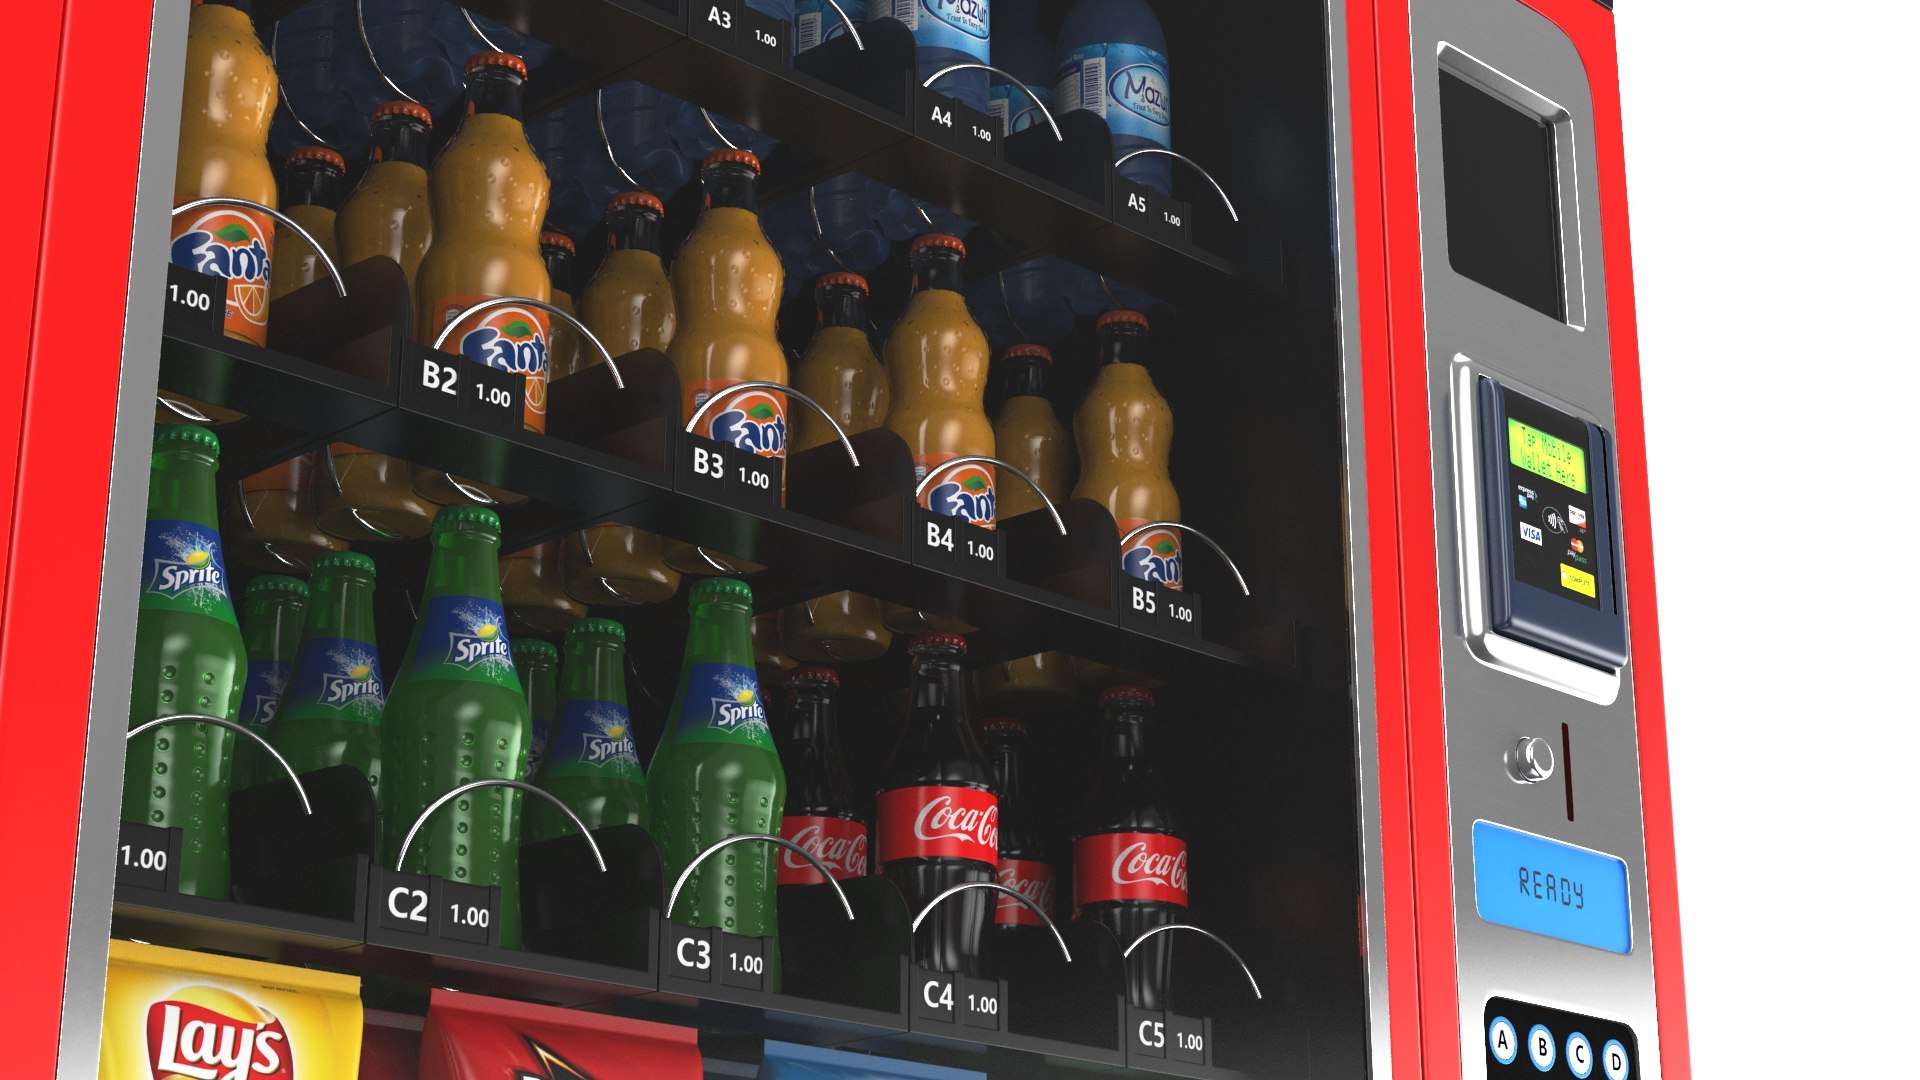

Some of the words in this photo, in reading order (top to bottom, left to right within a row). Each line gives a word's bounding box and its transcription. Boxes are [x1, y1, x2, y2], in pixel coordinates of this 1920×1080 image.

[708, 5, 731, 29] A3
[755, 29, 777, 47] 1.00
[931, 105, 953, 128] A4
[972, 126, 991, 142] 1.00
[1127, 192, 1146, 213] A5
[1163, 211, 1181, 227] 1.00
[169, 284, 210, 311] 1.00
[422, 359, 458, 396] B2
[476, 383, 511, 408] 1.00
[693, 446, 724, 479] B3
[738, 466, 769, 489] 1.00
[927, 481, 996, 523] Fant
[927, 521, 954, 552] B4
[967, 540, 994, 561] 1.00
[1523, 526, 1541, 542] VISA
[158, 562, 220, 592] Sprite
[1132, 586, 1156, 614] B5
[1168, 603, 1193, 622] 1.00
[454, 637, 508, 662] Sprite
[327, 678, 380, 702] Sprite
[717, 702, 764, 727] Sprite
[588, 735, 634, 761] Sprite
[120, 845, 167, 871] 1.00
[1519, 866, 1584, 909] READY
[388, 886, 428, 922] C2
[450, 903, 489, 928] 1.00
[677, 937, 711, 970] C3
[729, 952, 763, 975] 1.00
[923, 980, 954, 1011] C4
[968, 994, 998, 1015] 1.00
[158, 1004, 282, 1080] Lay's
[1138, 1020, 1165, 1048] C5
[1177, 1032, 1203, 1051] 1.00
[1497, 1030, 1508, 1050] A
[1539, 1037, 1547, 1057] B
[1575, 1045, 1584, 1063] C
[1612, 1053, 1621, 1071] D
